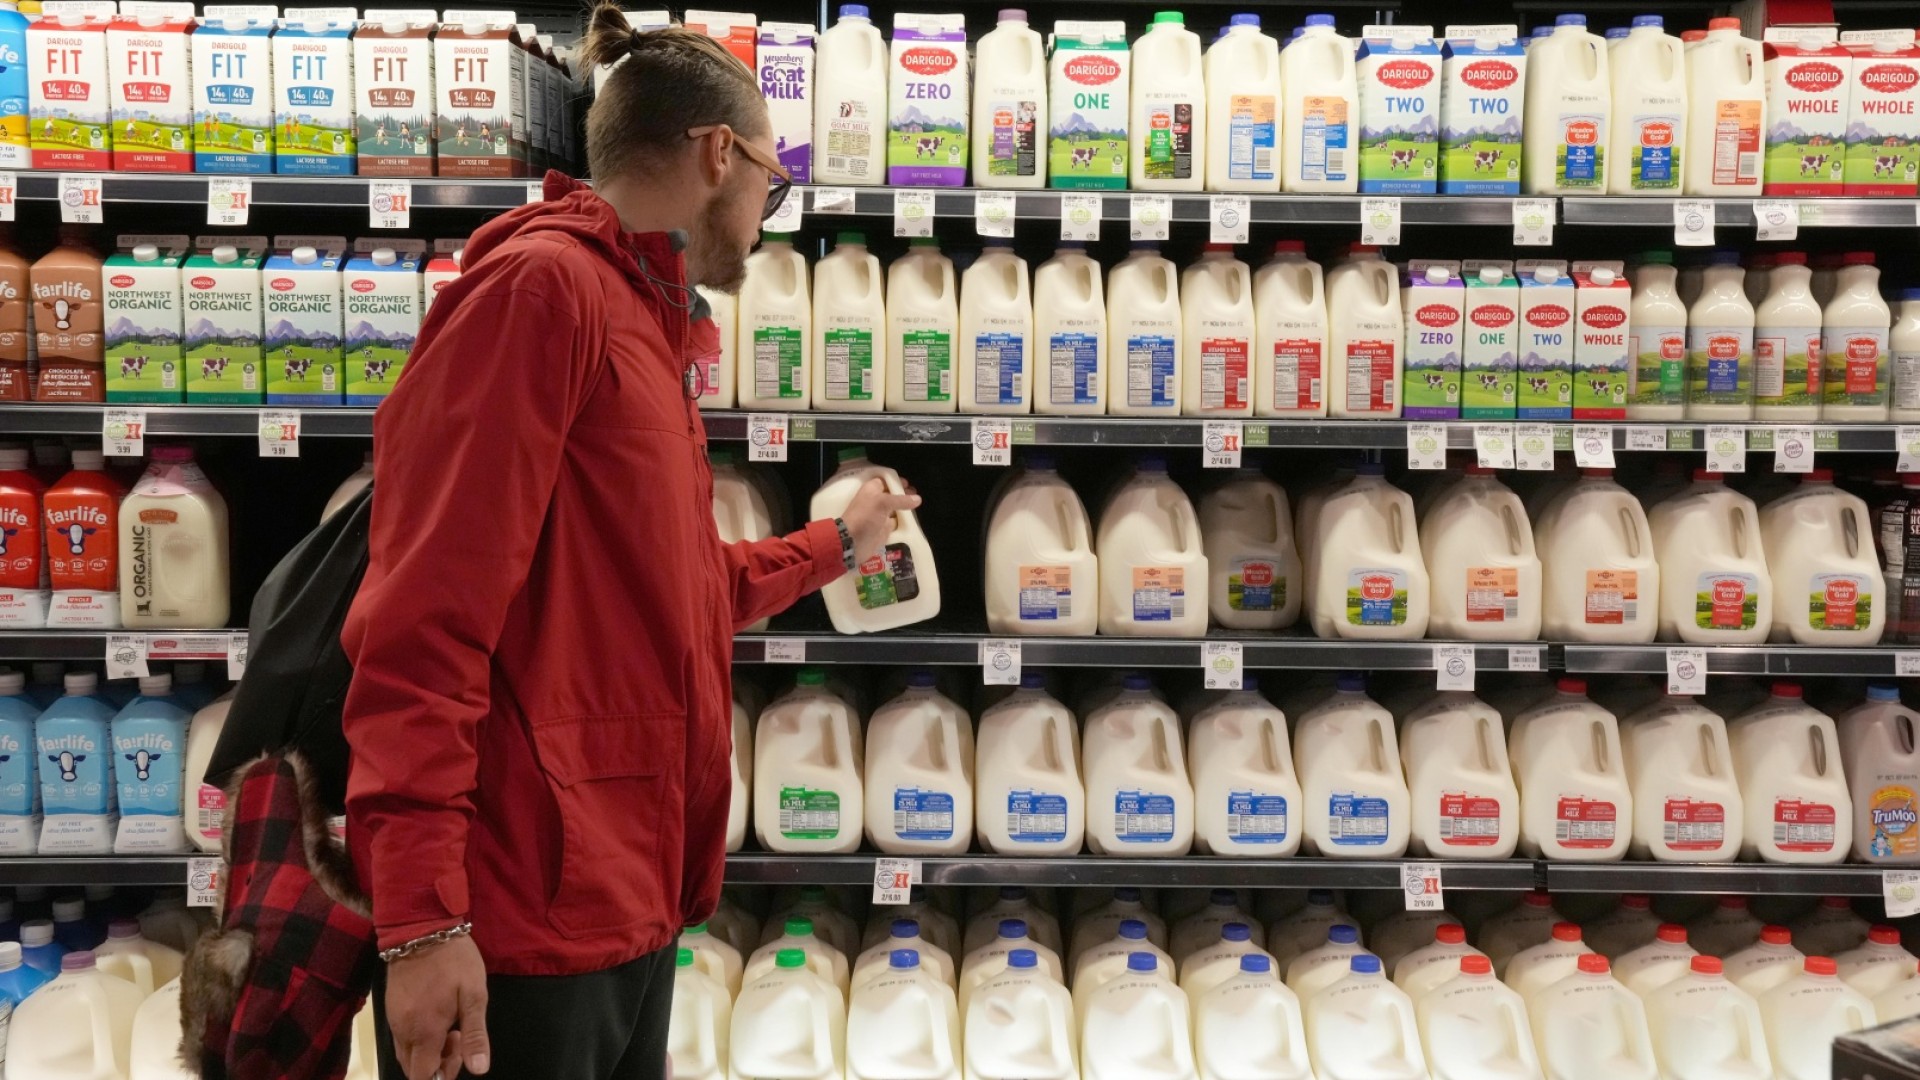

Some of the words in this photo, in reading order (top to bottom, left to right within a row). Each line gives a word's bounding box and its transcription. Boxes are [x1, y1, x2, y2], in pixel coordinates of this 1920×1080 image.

[47, 38, 82, 46] DARIGOLD
[128, 39, 162, 47] DARIGOLD
[212, 42, 246, 50] DARIGOLD
[47, 49, 82, 74] FIT
[128, 51, 162, 76] FIT
[212, 54, 246, 78] FIT
[906, 56, 952, 66] DARIGOLD
[293, 56, 326, 80] FIT
[374, 58, 408, 82] FIT
[454, 58, 488, 82] FIT
[1070, 66, 1116, 75] DARIGOLD
[761, 66, 805, 82] Goat
[1383, 69, 1429, 79] DARIGOLD
[1467, 70, 1512, 80] DARIGOLD
[1792, 72, 1838, 82] DARIGOLD
[1866, 73, 1914, 82] DARIGOLD
[762, 82, 804, 99] Milk
[906, 84, 951, 99] ZERO
[1074, 93, 1110, 109] ONE
[1385, 97, 1424, 113] TWO
[1470, 98, 1509, 114] TWO
[1788, 100, 1838, 112] WHOLE
[1862, 101, 1914, 114] WHOLE
[1802, 205, 1820, 213] WIC
[189, 292, 252, 300] NORTHWEST
[109, 300, 172, 310] ORGANIC
[190, 301, 252, 310] ORGANIC
[269, 302, 331, 312] ORGANIC
[350, 304, 411, 314] ORGANIC
[1530, 312, 1566, 320] DARIGOLD
[1420, 333, 1453, 344] ZERO
[1480, 333, 1505, 344] ONE
[1534, 334, 1562, 345] TWO
[1584, 335, 1623, 345] WHOLE
[794, 420, 812, 428] WIC
[1248, 426, 1266, 434] WIC
[0, 508, 28, 525] life
[132, 525, 146, 598] ORGANIC
[1872, 810, 1916, 824] TruMoo
